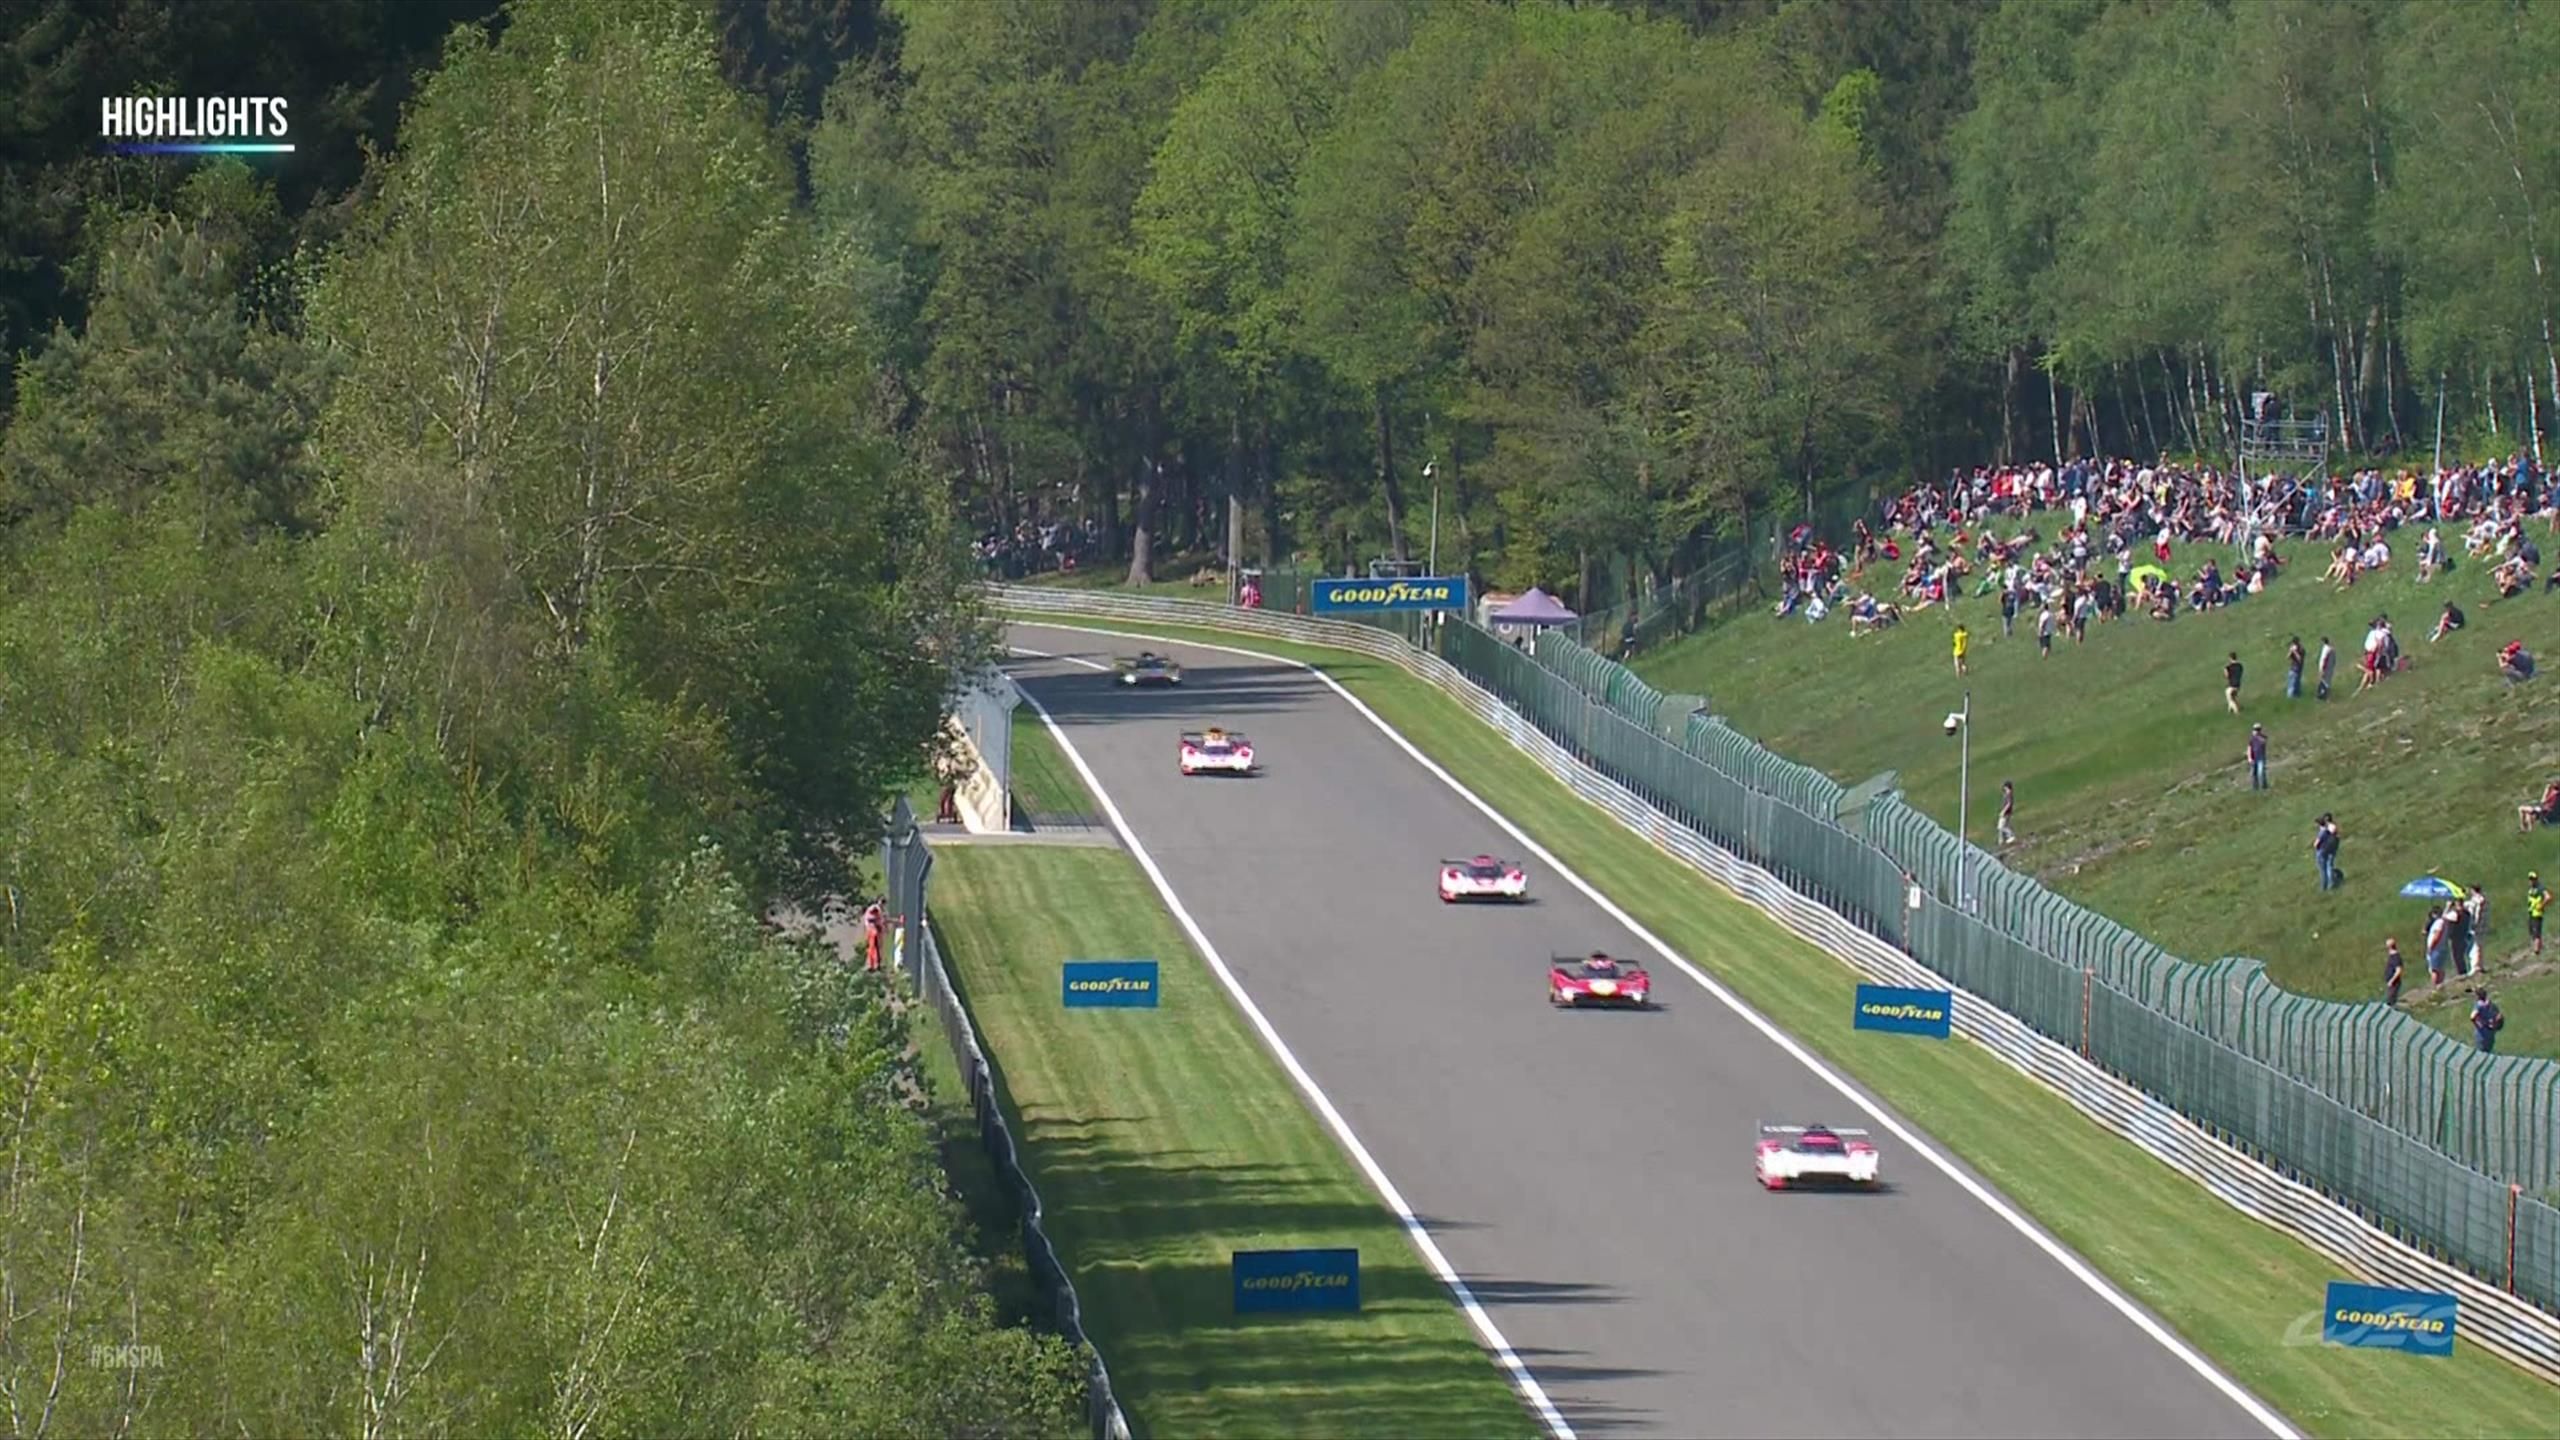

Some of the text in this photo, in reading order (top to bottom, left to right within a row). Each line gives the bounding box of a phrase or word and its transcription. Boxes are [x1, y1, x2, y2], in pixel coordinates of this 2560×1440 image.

[1329, 582, 1449, 605] GOODYEAR
[1070, 977, 1150, 992] GOODYEAR
[1862, 1003, 1942, 1021] GOODYEAR
[1243, 1271, 1349, 1292] GOODYEAR
[2335, 1309, 2444, 1333] GOODYEAR
